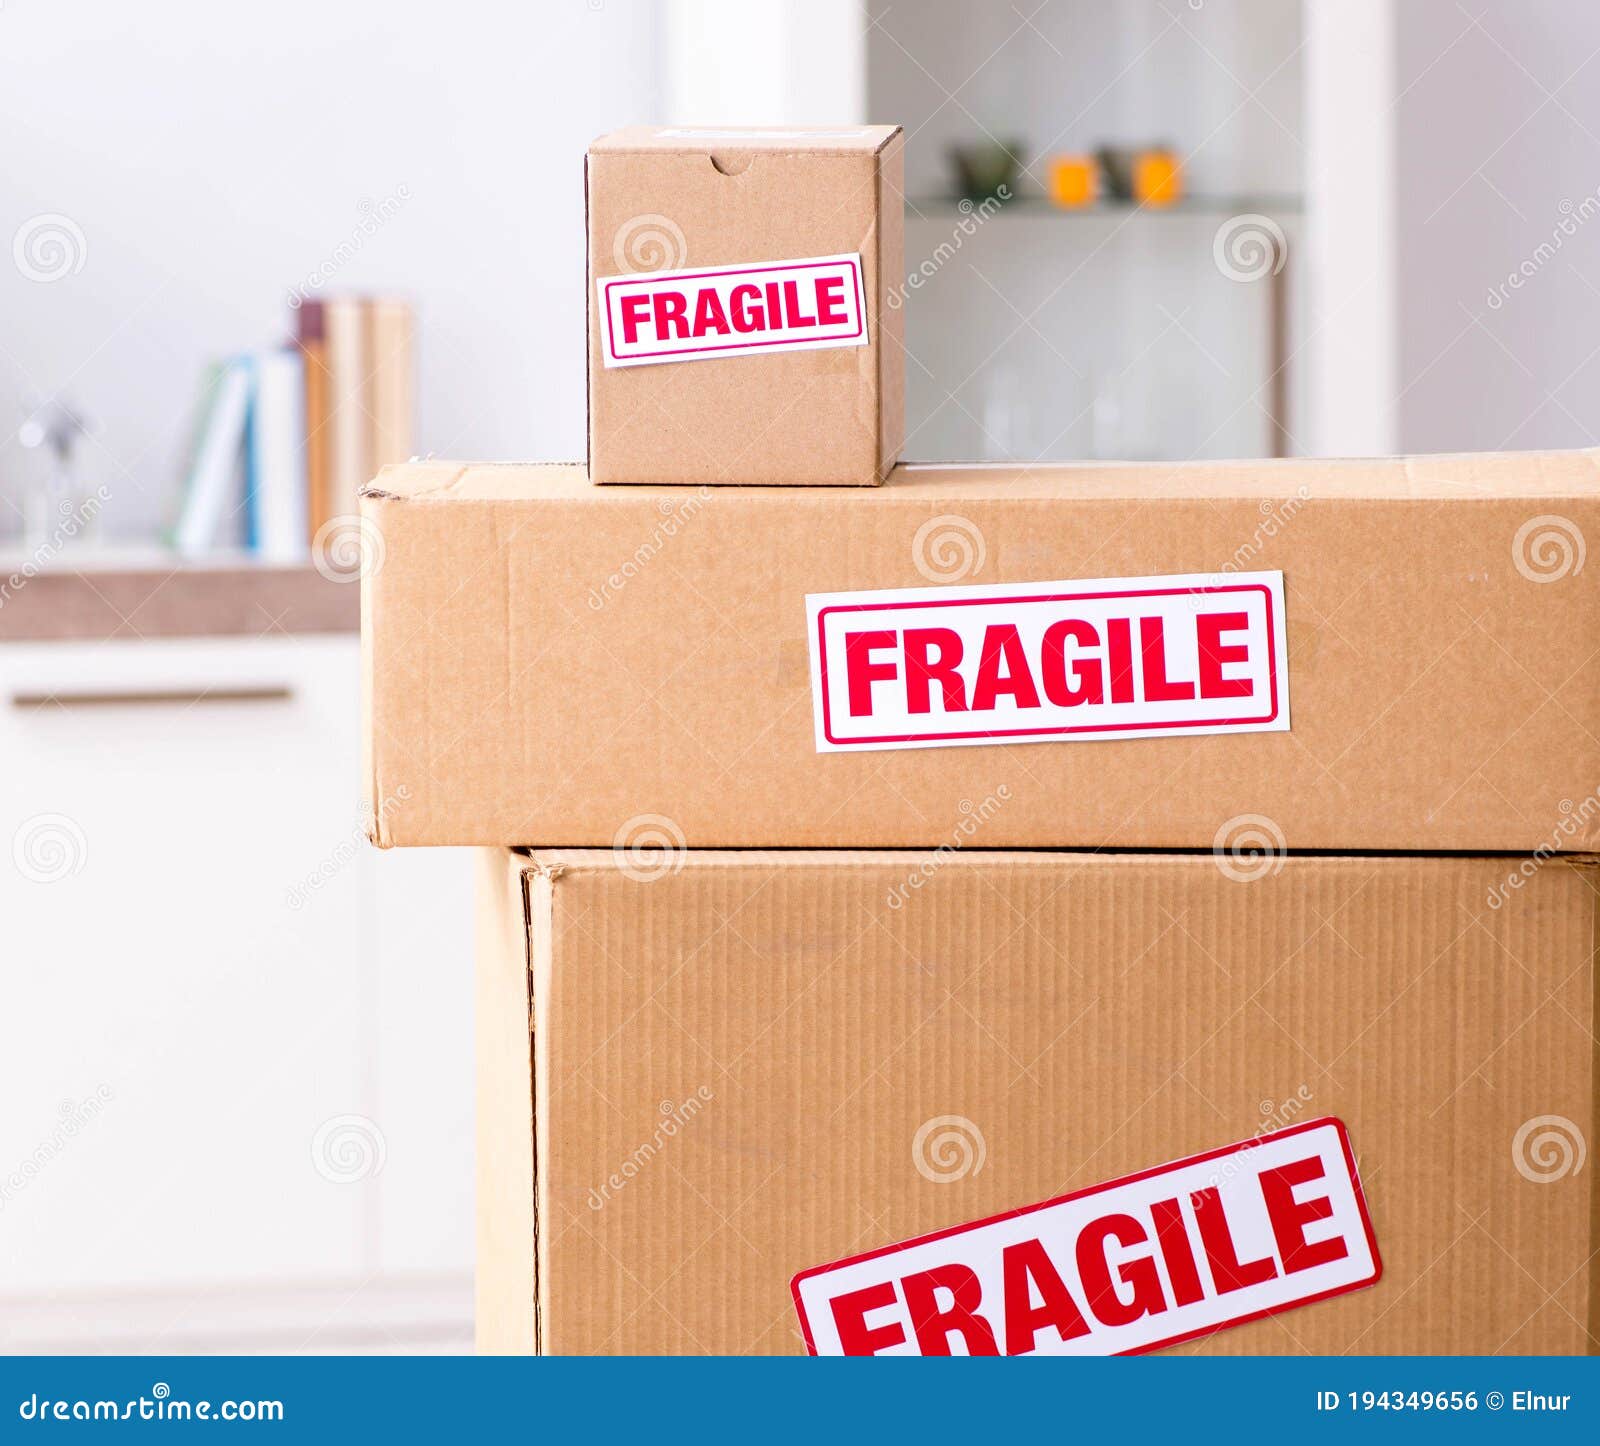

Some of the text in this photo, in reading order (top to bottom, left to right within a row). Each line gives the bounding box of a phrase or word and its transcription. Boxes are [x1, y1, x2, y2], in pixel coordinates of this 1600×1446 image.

[620, 276, 848, 344] FRAGILE
[845, 612, 1253, 717] FRAGILE
[829, 1155, 1348, 1356] FRAGILE
